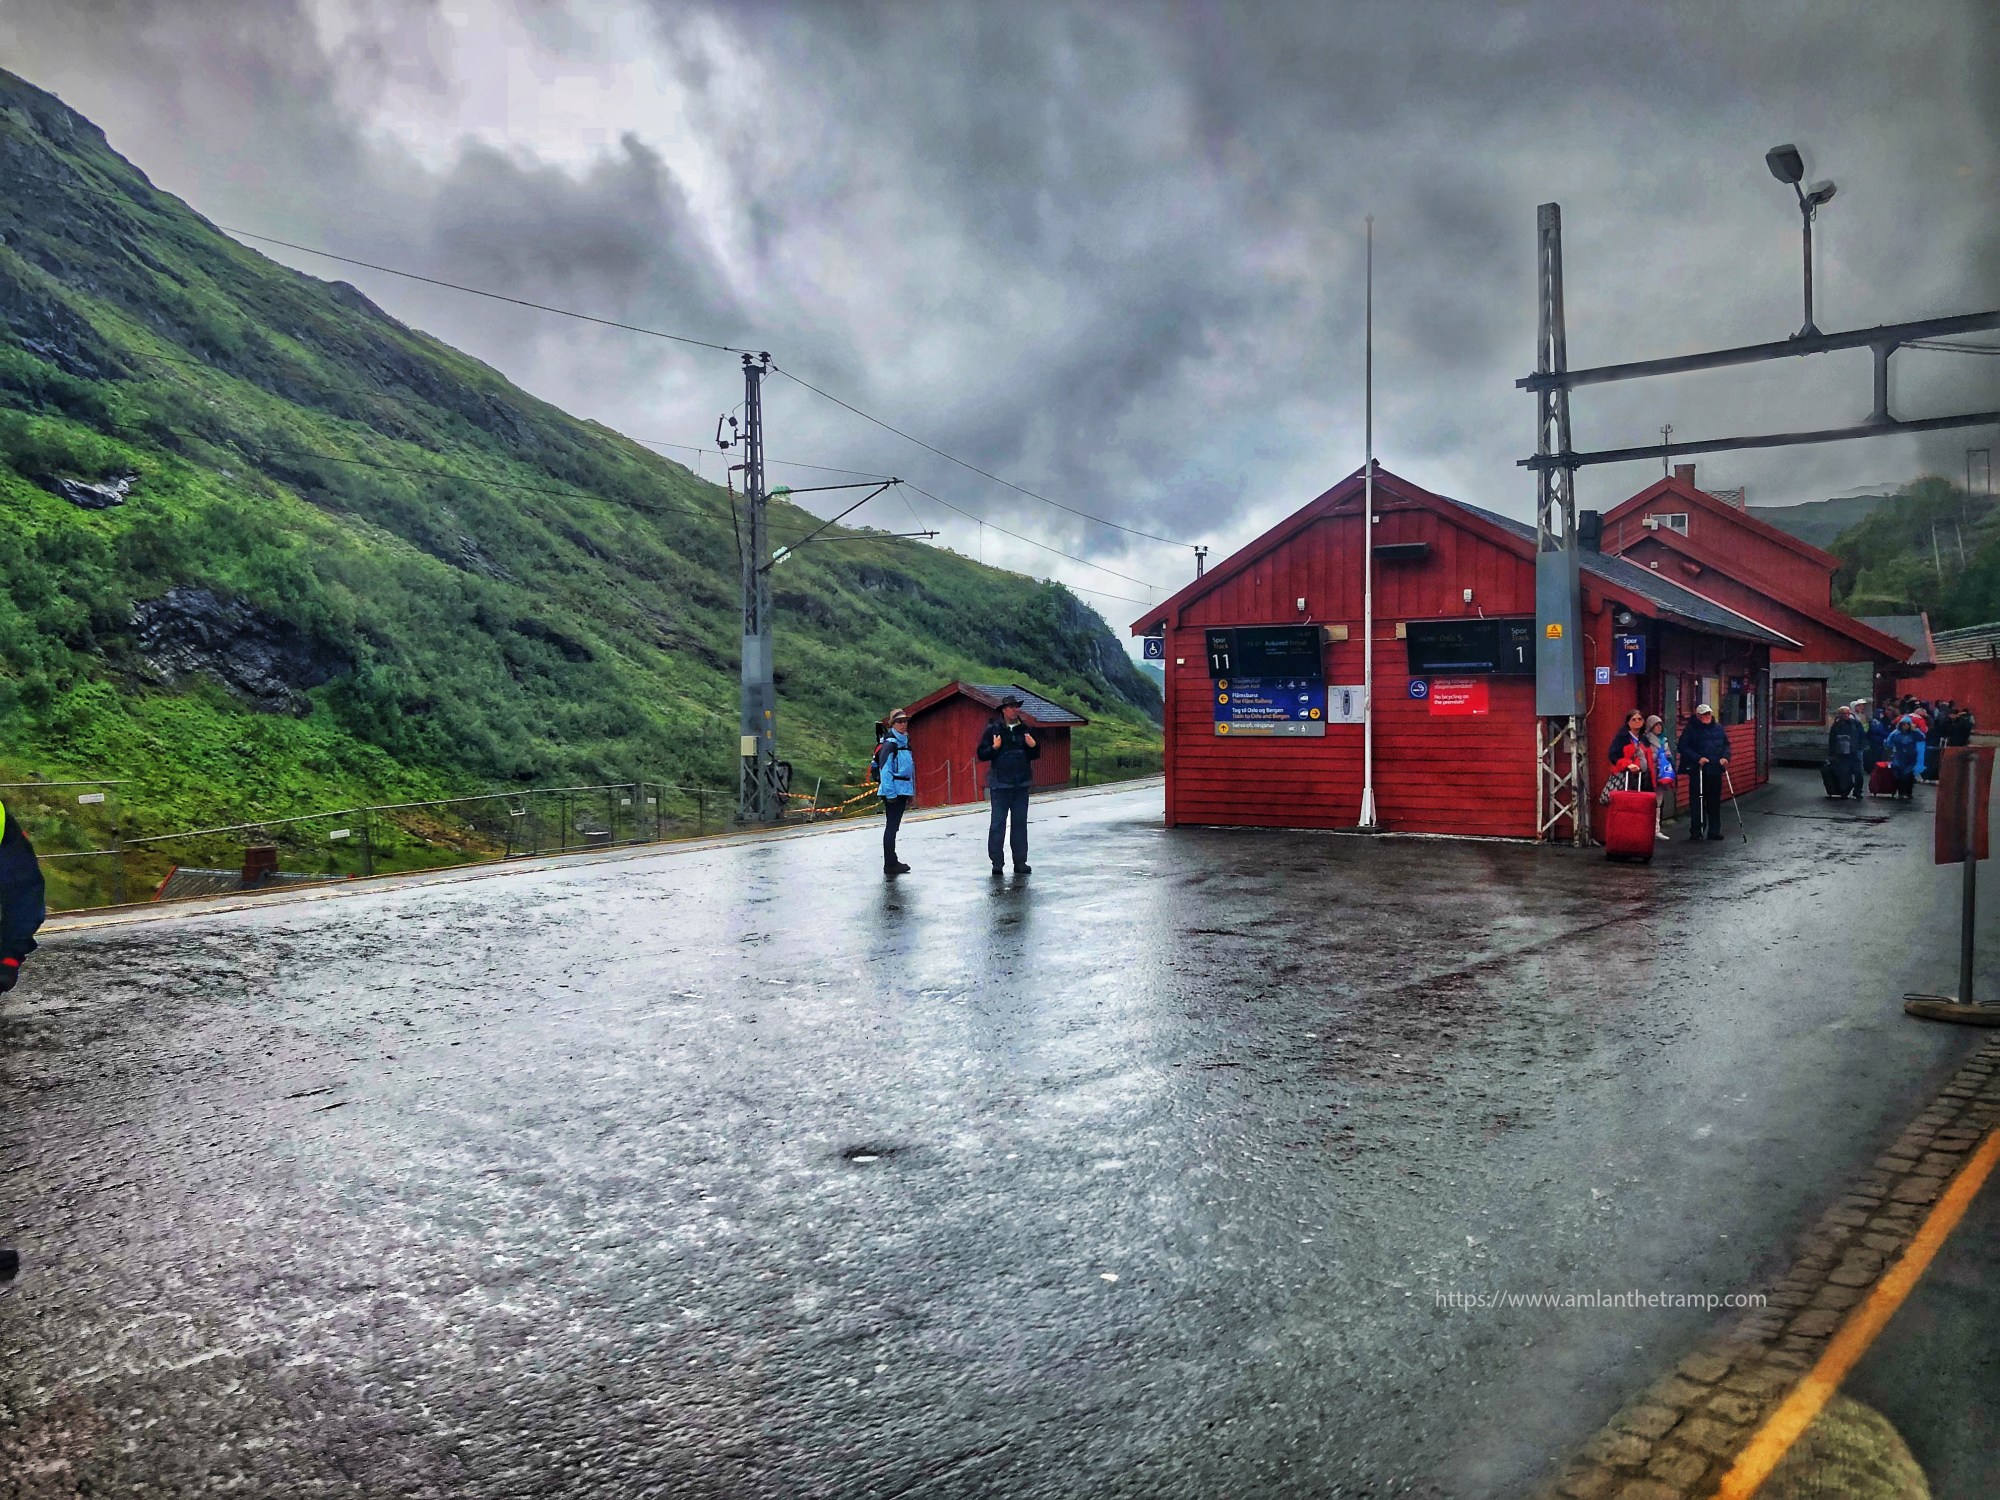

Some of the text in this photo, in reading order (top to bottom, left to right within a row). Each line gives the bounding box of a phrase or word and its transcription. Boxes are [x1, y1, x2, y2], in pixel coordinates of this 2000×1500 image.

[1212, 653, 1230, 670] 11
[1515, 646, 1523, 664] 1
[1626, 652, 1634, 668] 1
